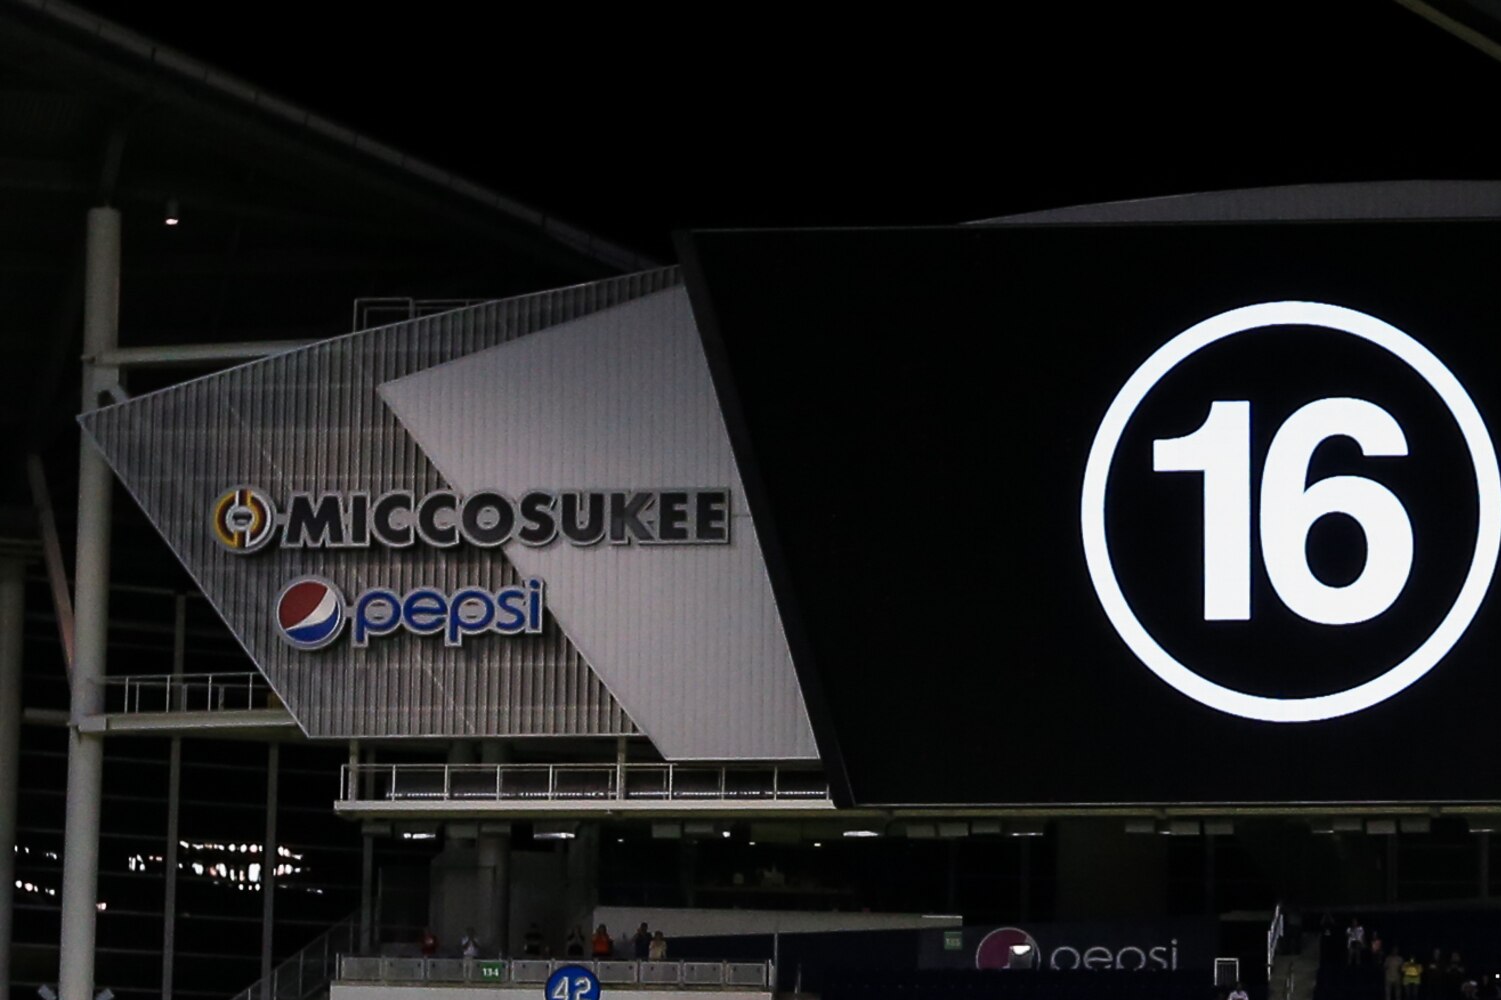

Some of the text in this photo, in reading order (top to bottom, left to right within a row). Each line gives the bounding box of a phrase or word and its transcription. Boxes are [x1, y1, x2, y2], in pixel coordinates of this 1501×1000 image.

[283, 491, 731, 548] MICCOSUKEE
[1153, 397, 1414, 625] 16
[352, 579, 544, 647] pepsi
[482, 968, 499, 976] 134
